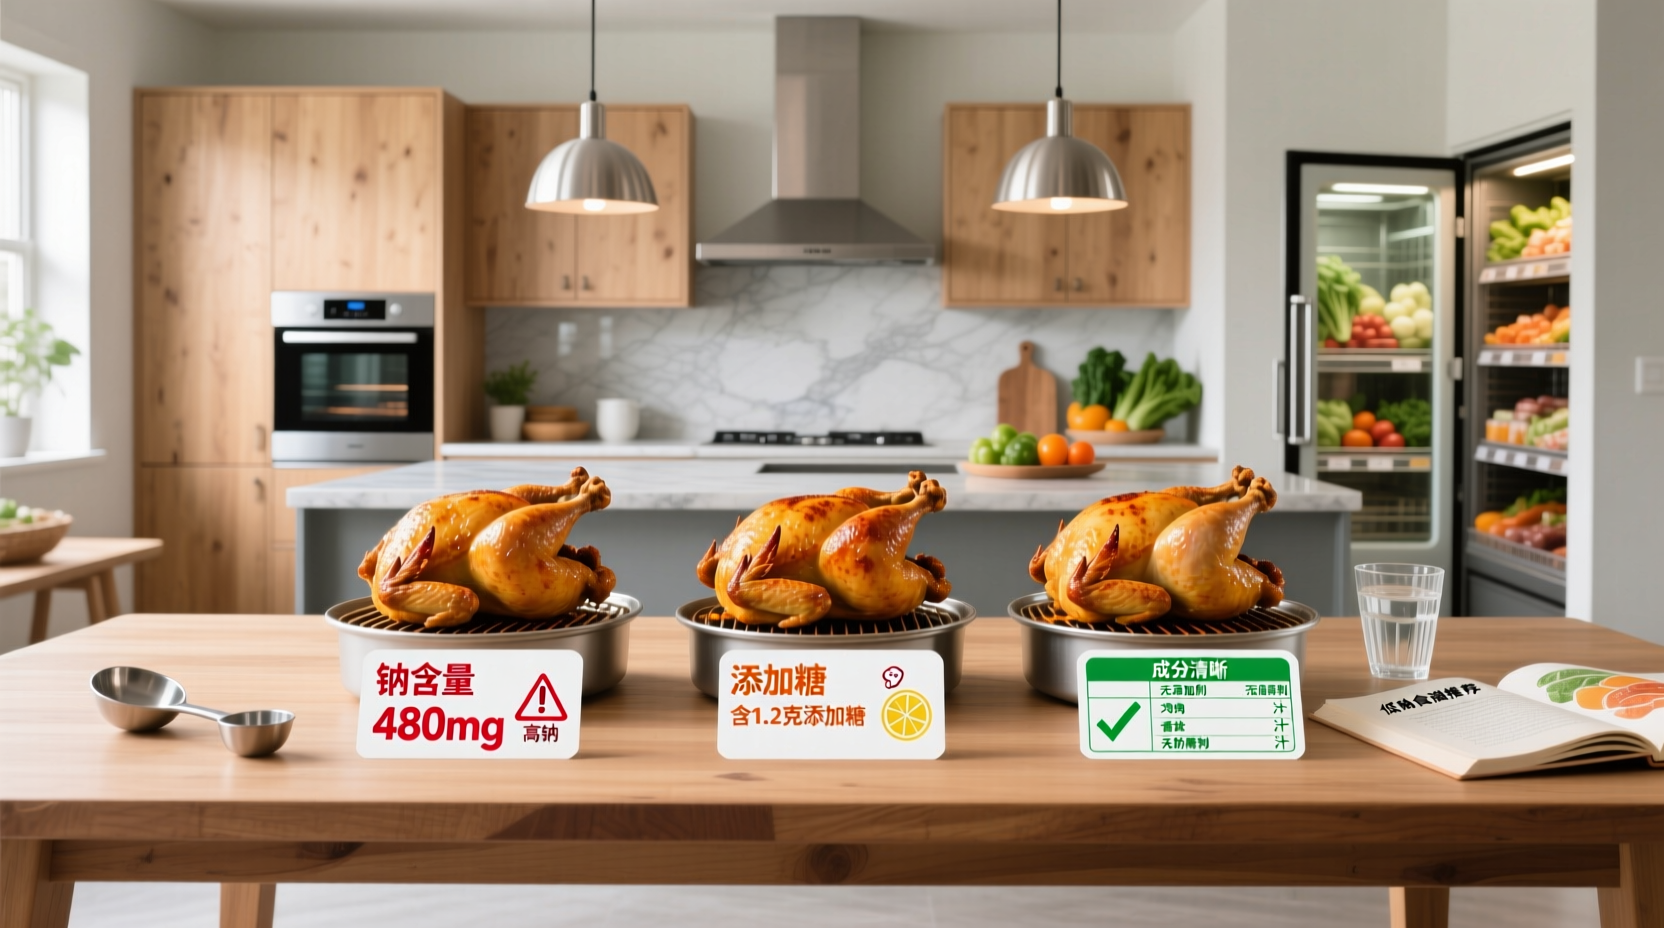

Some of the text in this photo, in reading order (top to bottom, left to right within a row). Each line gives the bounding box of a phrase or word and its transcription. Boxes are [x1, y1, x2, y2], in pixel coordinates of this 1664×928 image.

[376, 662, 475, 697] 钠含量
[730, 663, 827, 697] 添加糖
[372, 706, 505, 751] 480mg
[730, 704, 866, 727] 含1.2克添加糖
[523, 723, 559, 743] 高钠
